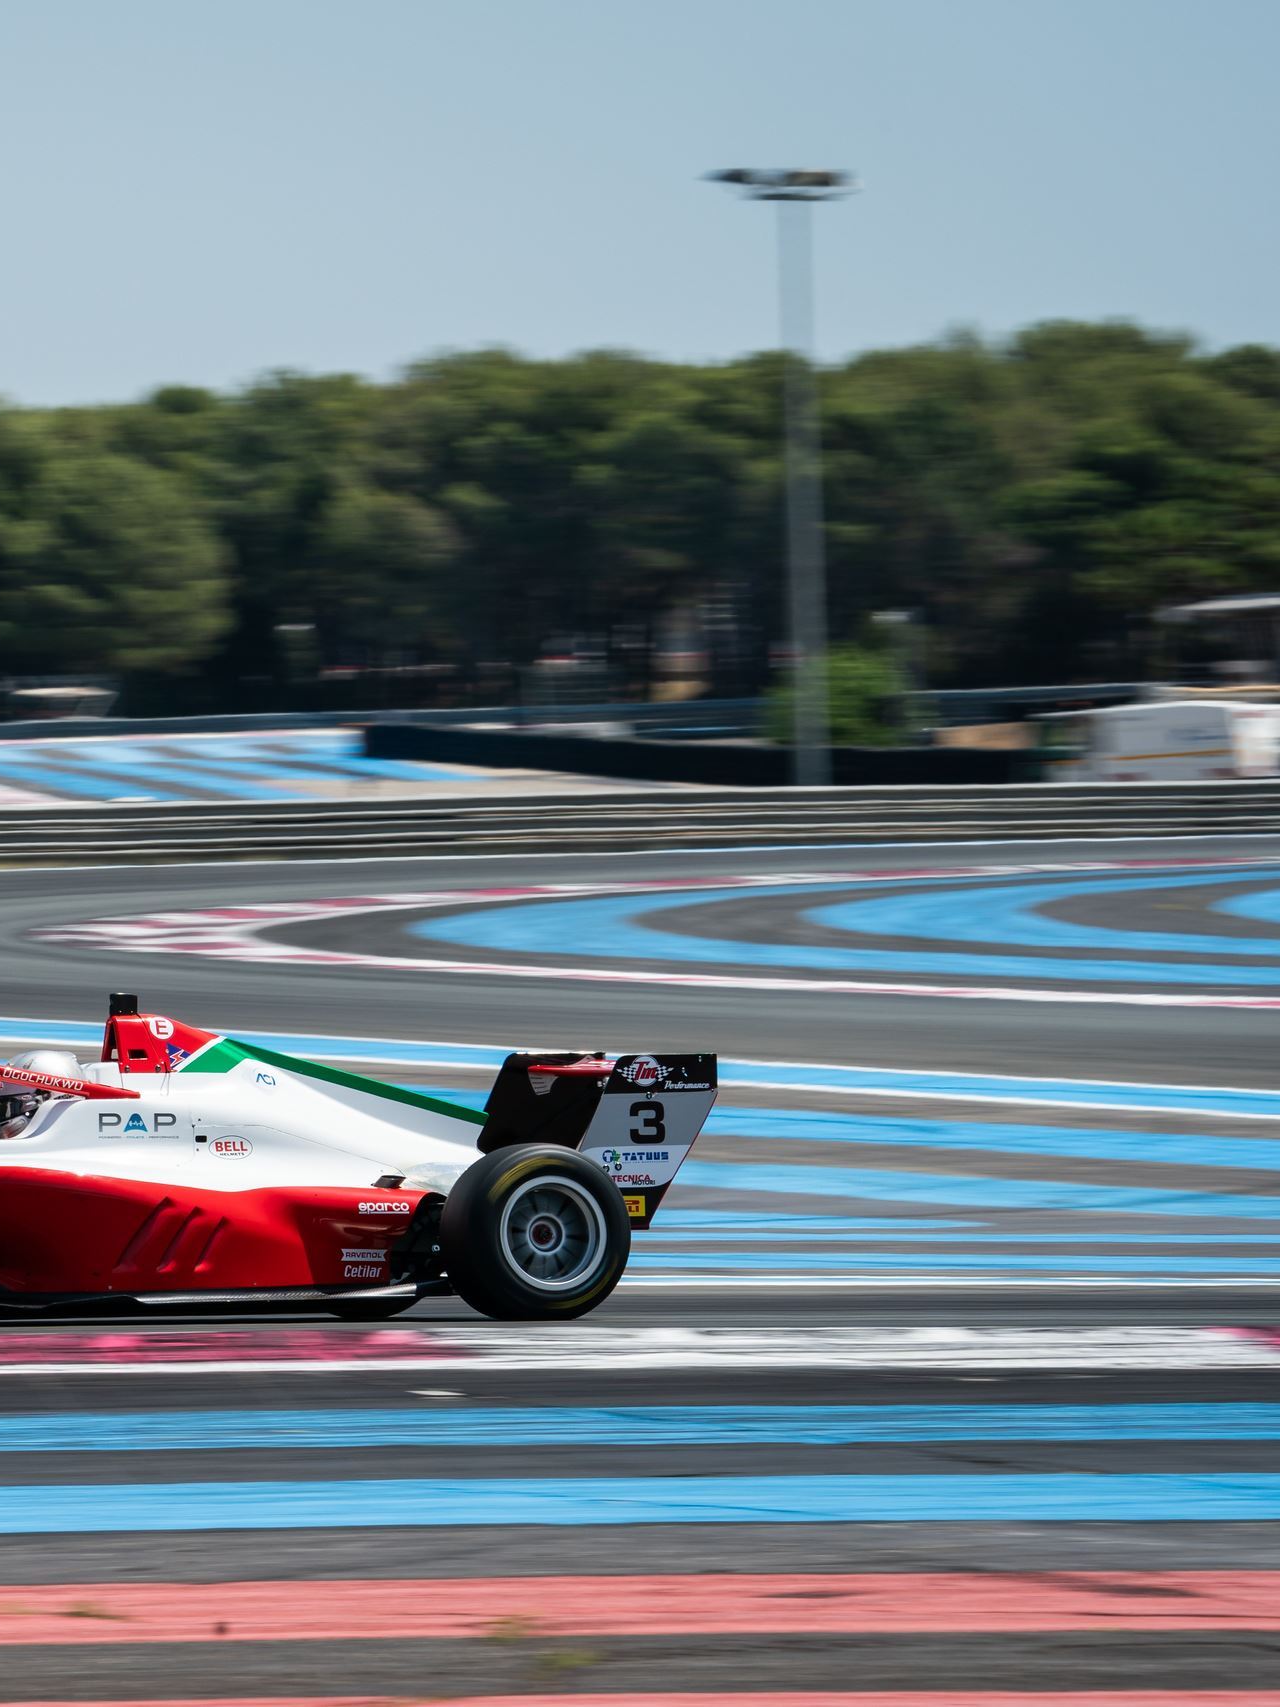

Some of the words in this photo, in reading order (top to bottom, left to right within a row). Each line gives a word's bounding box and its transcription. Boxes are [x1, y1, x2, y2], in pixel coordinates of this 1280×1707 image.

[155, 1020, 169, 1035] E
[629, 1101, 666, 1144] 3
[215, 1141, 248, 1152] BELL
[622, 1151, 669, 1161] TATUUS
[358, 1202, 410, 1214] sparco
[345, 1251, 383, 1259] RAVENOL
[344, 1264, 382, 1278] Cetilar
